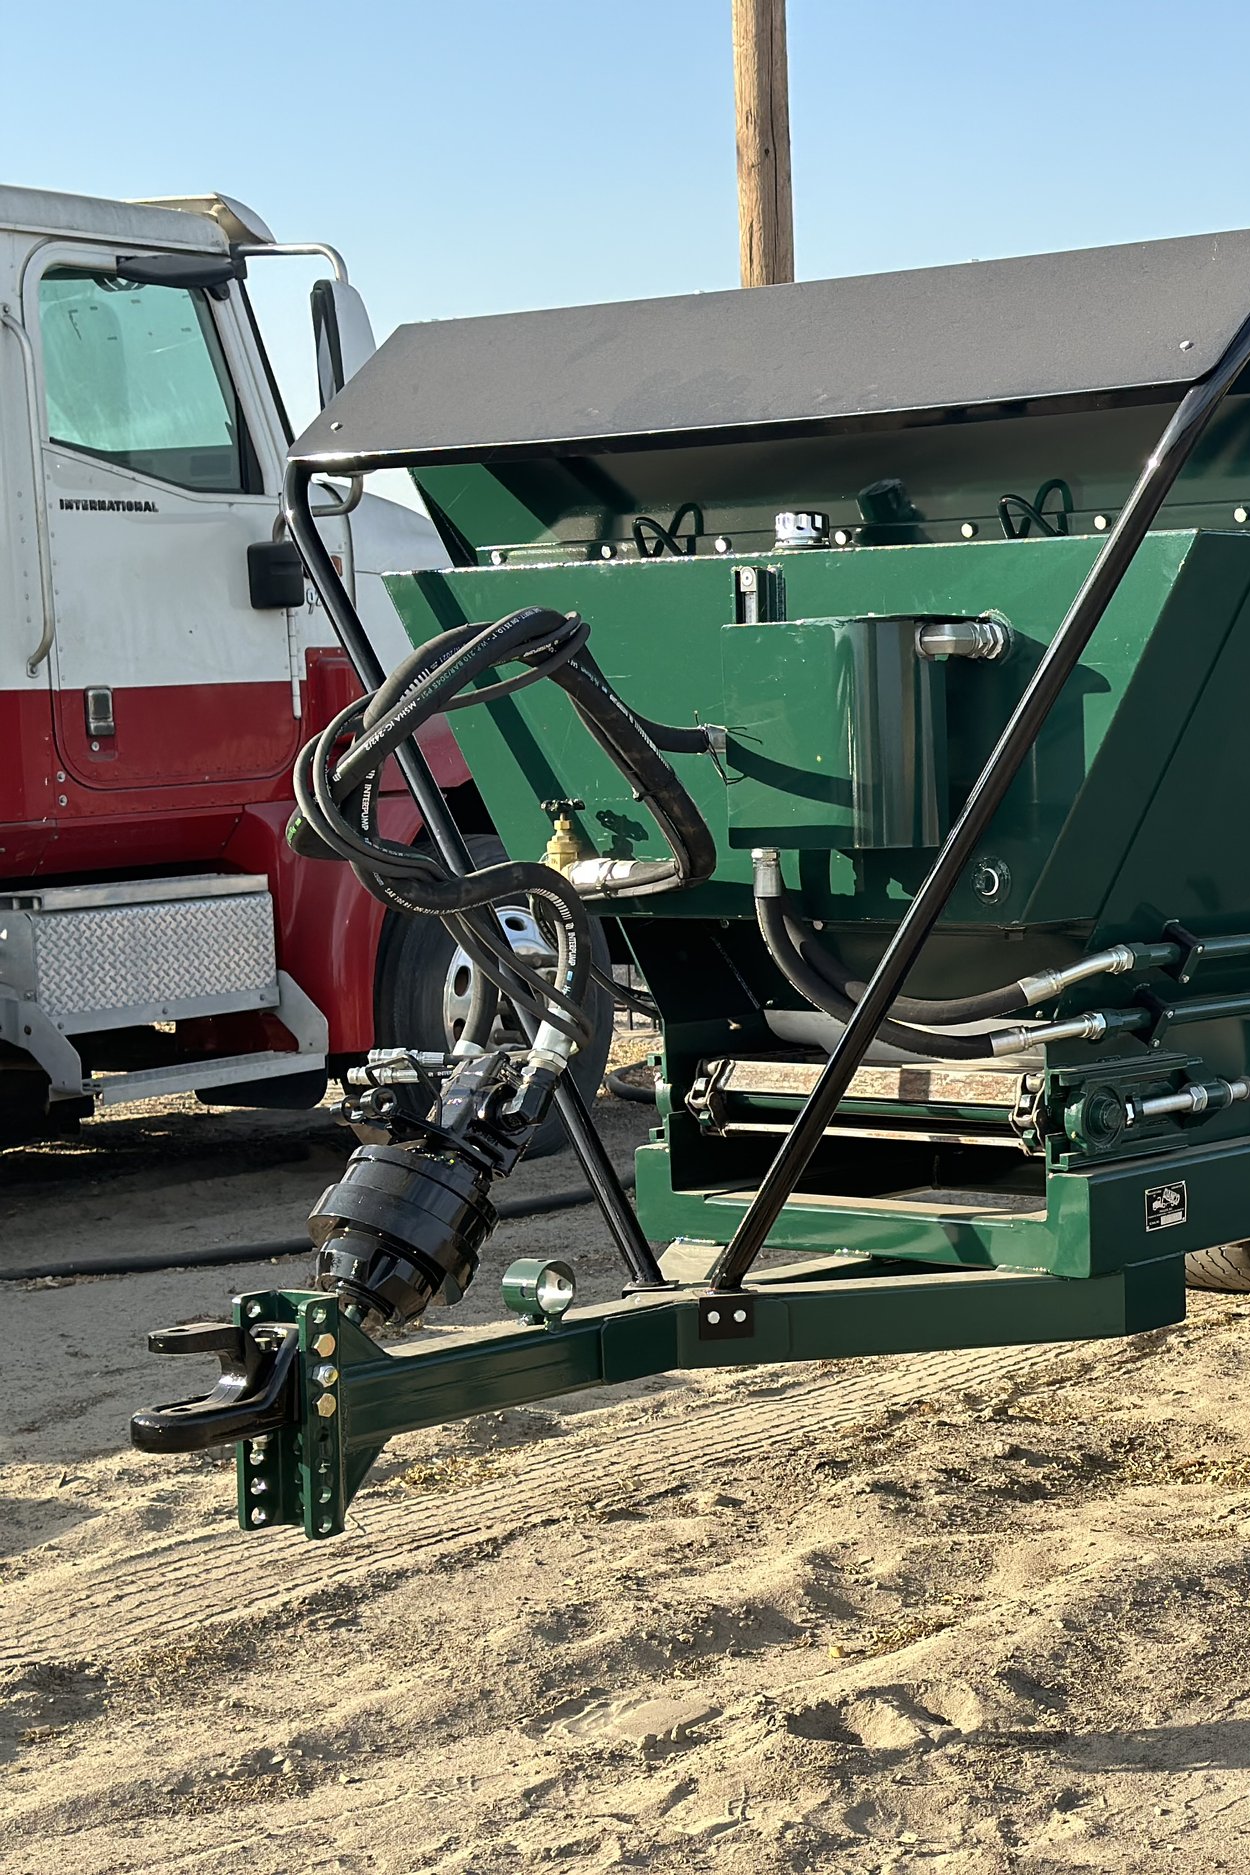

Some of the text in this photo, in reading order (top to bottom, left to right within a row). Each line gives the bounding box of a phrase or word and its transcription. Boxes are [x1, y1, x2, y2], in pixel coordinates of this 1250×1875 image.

[59, 498, 159, 513] INTERNATIONAL
[462, 650, 476, 663] 210
[431, 660, 465, 690] BAR/3045
[420, 686, 433, 700] PSI
[393, 700, 417, 722] MSHA
[364, 720, 395, 751] IC-242/2
[361, 784, 372, 831] INTERPUMP
[567, 931, 577, 967] INTERPUMP
